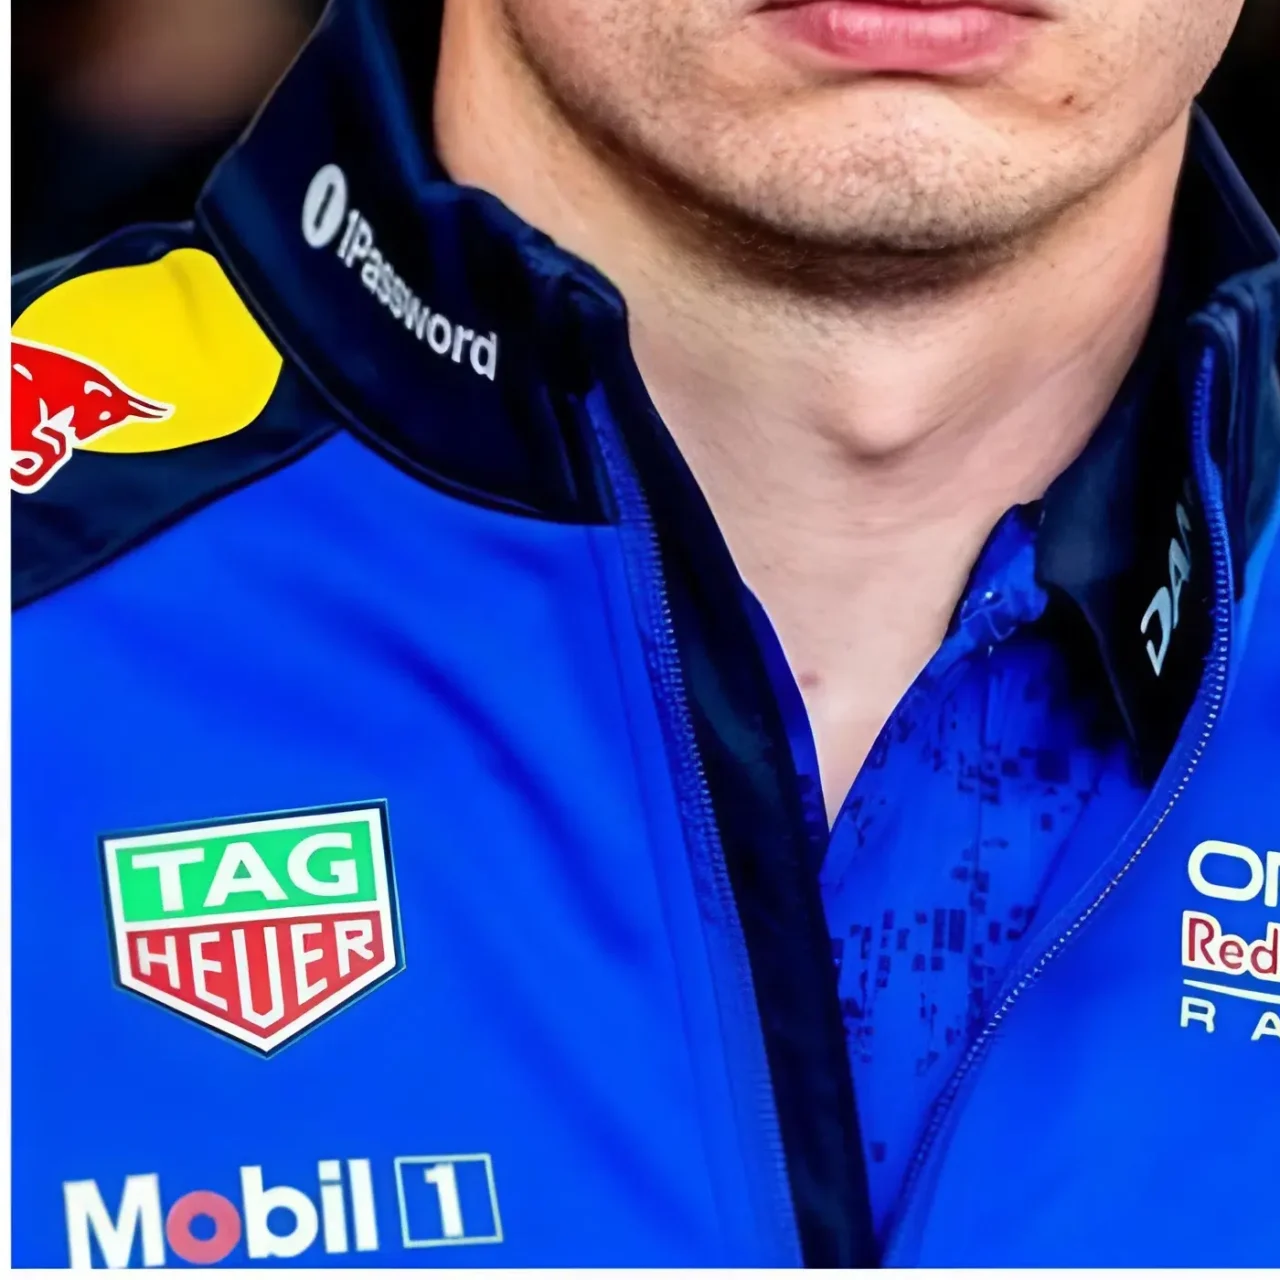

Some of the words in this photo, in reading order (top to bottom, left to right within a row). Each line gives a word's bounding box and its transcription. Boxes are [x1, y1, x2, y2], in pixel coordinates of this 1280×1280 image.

[336, 209, 498, 382] 1Password
[131, 832, 360, 912] TAG
[136, 920, 375, 1029] HEUER
[62, 1158, 379, 1270] Mobil
[424, 1163, 464, 1239] 1
